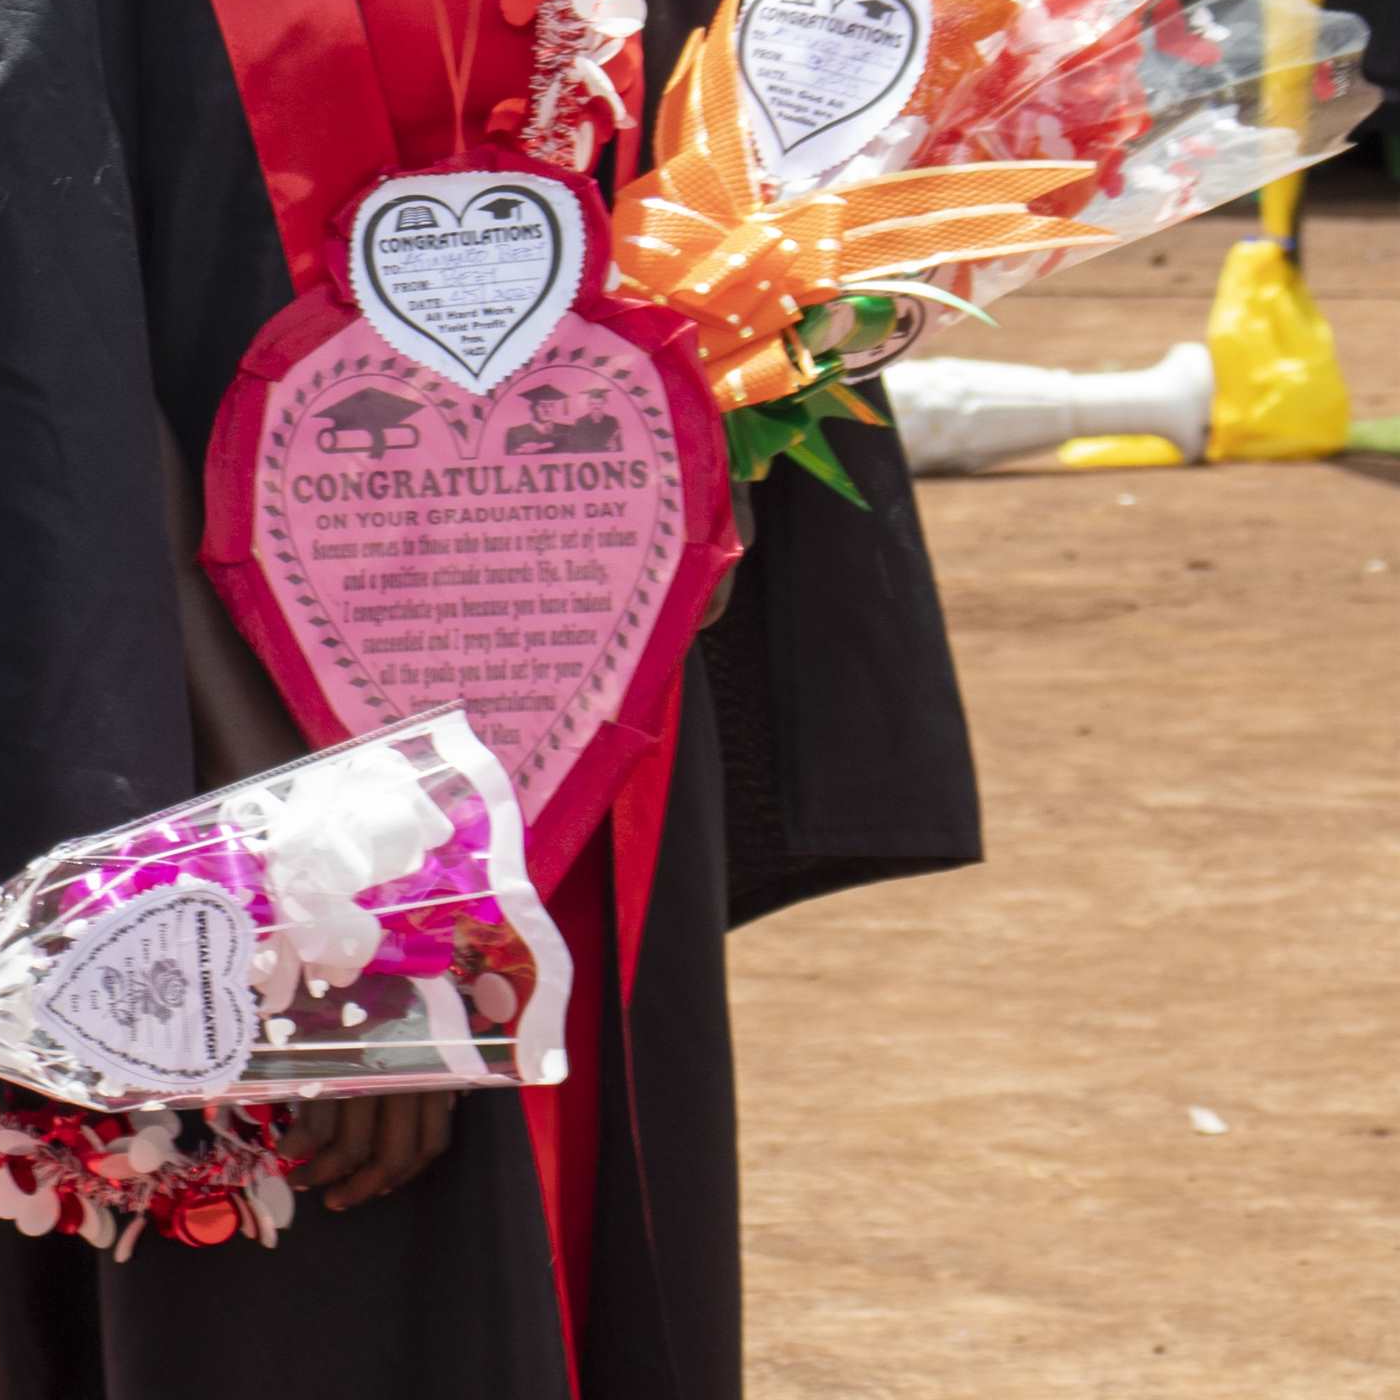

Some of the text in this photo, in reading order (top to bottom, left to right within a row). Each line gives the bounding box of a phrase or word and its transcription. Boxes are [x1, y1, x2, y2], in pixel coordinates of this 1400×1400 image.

[760, 7, 903, 48] CONGRATULATIONS
[379, 224, 542, 254] CONGRATULATIONS
[293, 460, 647, 503] CONGRATULATIONS
[317, 502, 626, 530] ON YOUR GRADUATION DAY
[196, 909, 217, 1060] SPECIAL DEDICATION
